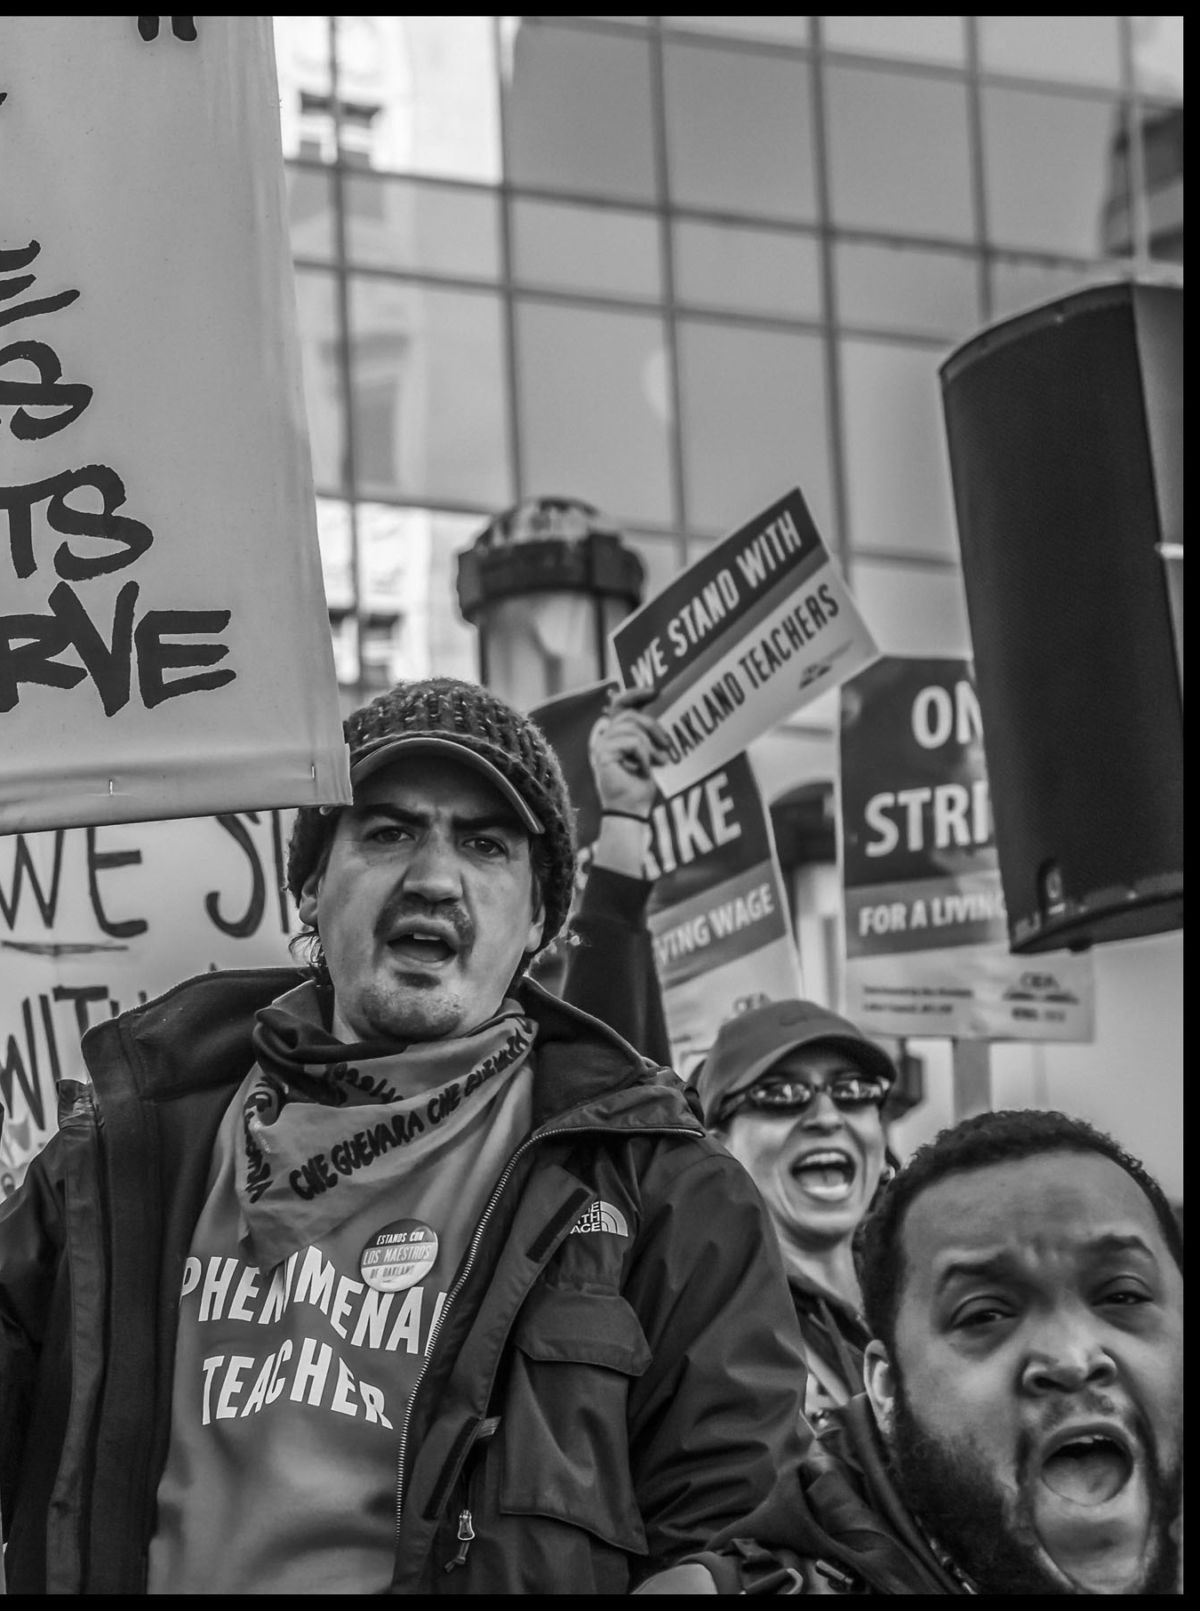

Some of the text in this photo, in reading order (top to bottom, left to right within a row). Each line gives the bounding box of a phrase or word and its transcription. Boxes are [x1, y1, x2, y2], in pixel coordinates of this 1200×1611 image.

[630, 510, 802, 691] WE STAND WITH
[738, 583, 840, 690] TEACHERS
[864, 780, 990, 858] STRI
[708, 882, 776, 939] WAGE
[858, 902, 908, 937] FOR
[911, 899, 928, 930] A
[362, 1245, 431, 1266] LOS MAESTROS
[202, 1337, 394, 1430] TEACHER
